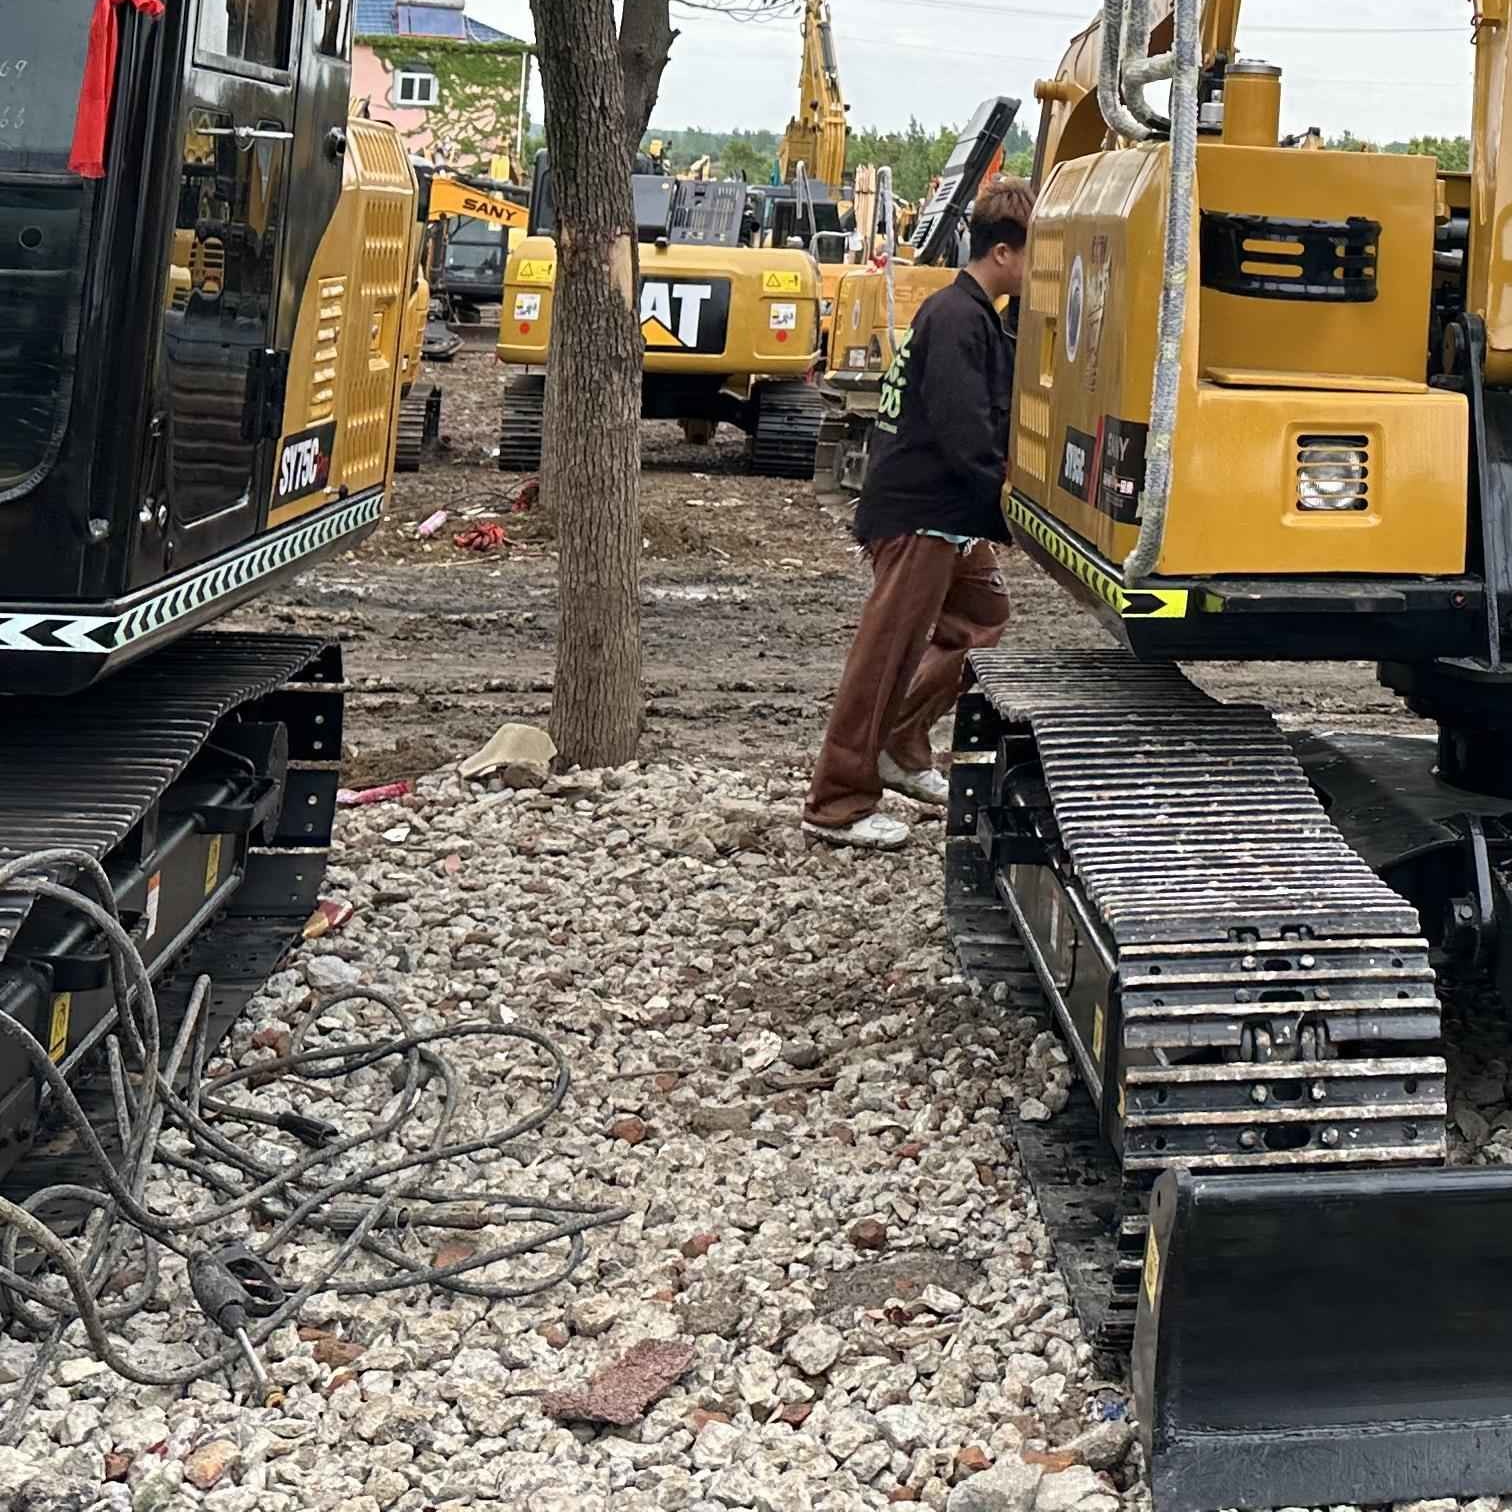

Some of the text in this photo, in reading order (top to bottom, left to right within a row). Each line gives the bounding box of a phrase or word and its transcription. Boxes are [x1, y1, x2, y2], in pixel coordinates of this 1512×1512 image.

[462, 198, 517, 221] SANY
[640, 282, 712, 347] AT
[279, 437, 319, 496] SY75C
